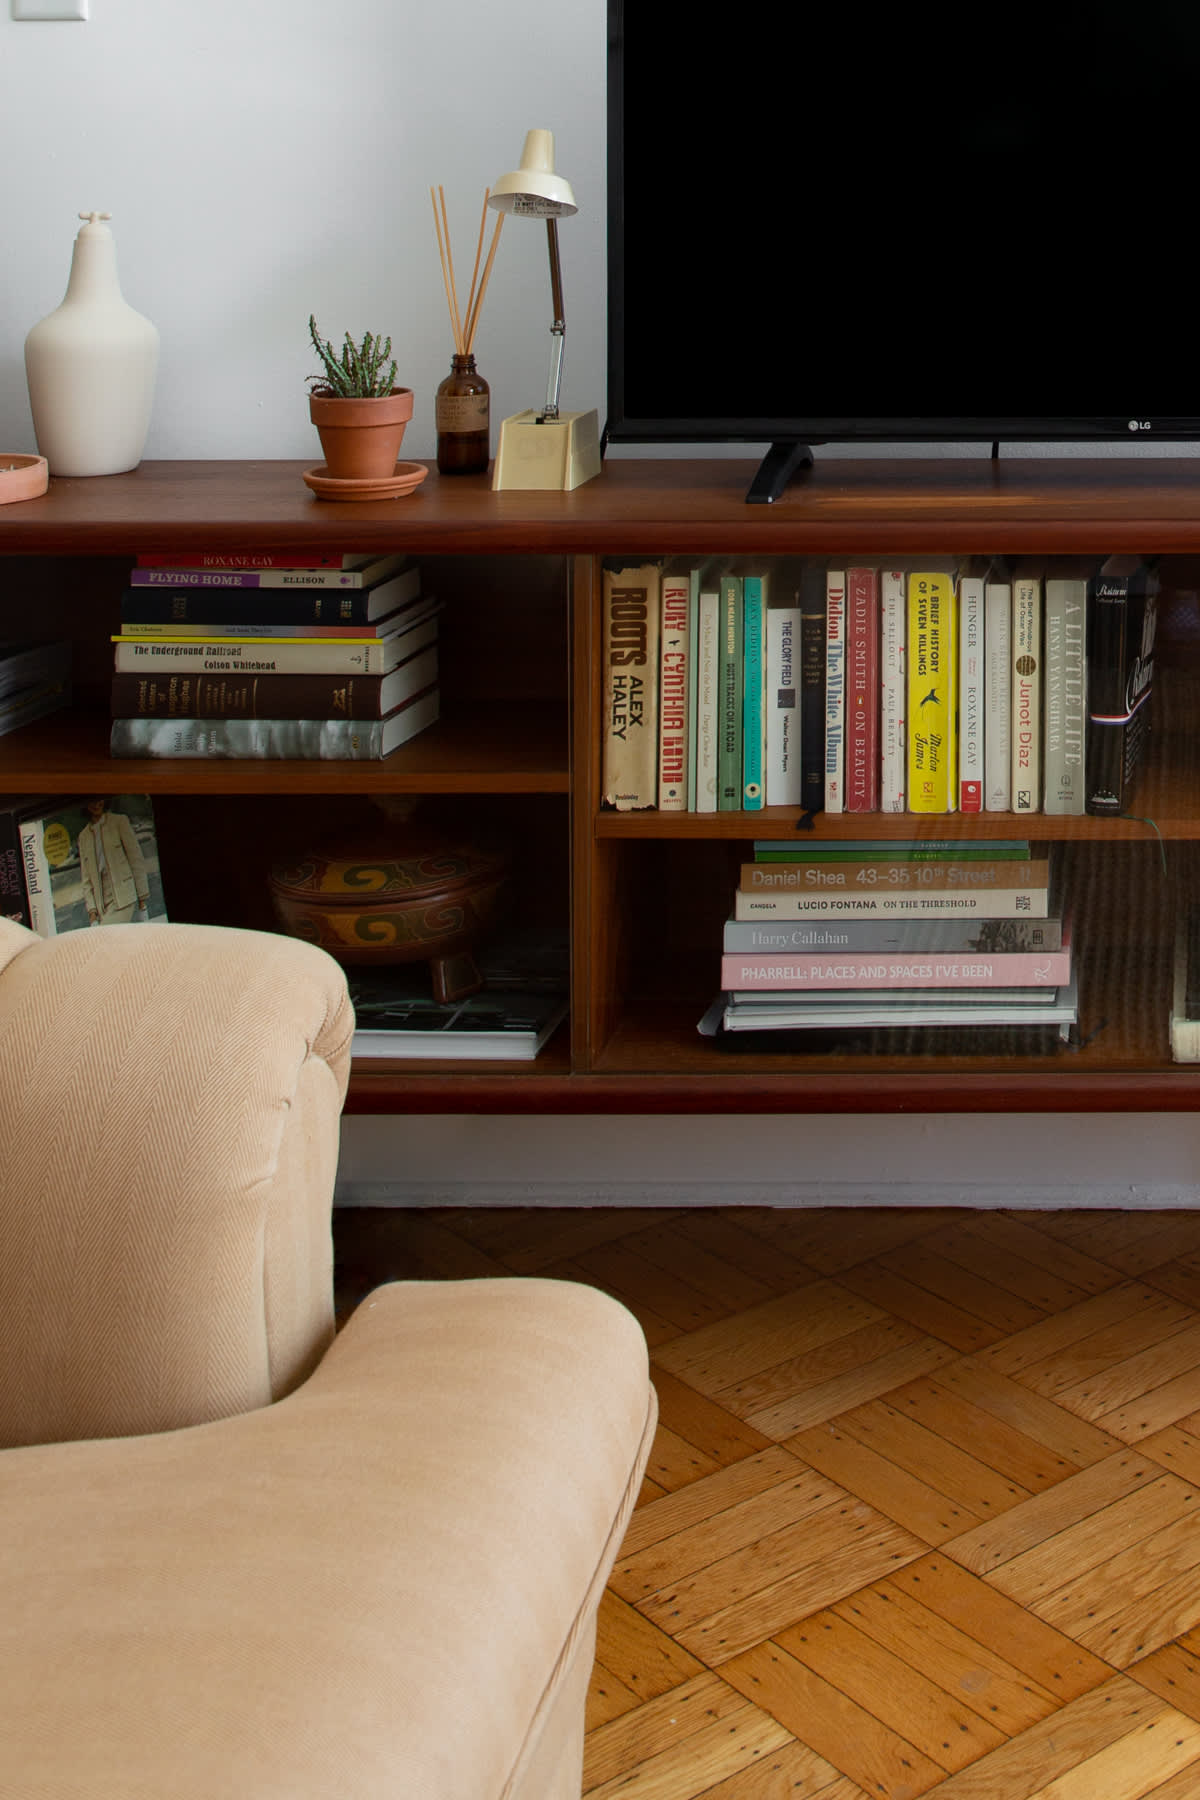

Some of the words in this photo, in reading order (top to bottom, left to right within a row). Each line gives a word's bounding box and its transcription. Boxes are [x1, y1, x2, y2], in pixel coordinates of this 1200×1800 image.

[203, 556, 251, 567] ROXANE
[252, 556, 273, 567] GAY
[150, 573, 198, 584] FLYING
[201, 574, 242, 586] HOME
[918, 581, 928, 594] OF
[664, 588, 688, 631] RUBY
[828, 588, 843, 639] Didion
[854, 587, 866, 634] ZADIE
[930, 596, 940, 625] BRIEF
[1019, 601, 1026, 609] of
[1065, 601, 1082, 615] A
[611, 588, 648, 666] ROOTS
[781, 621, 792, 636] THE
[967, 596, 977, 648] HUNGER
[1050, 616, 1060, 660] HANYA
[134, 646, 149, 655] The
[151, 646, 203, 657] Underground
[206, 646, 241, 656] Railroad
[204, 661, 230, 670] Colson
[233, 661, 276, 670] Whitehead
[781, 638, 792, 663] GLORY
[827, 641, 843, 672] The
[854, 641, 866, 690] SMITH
[918, 634, 928, 676] KILLINGS
[930, 629, 940, 673] HISTORY
[1065, 624, 1082, 706] LITTLE
[726, 663, 735, 680] DUST
[781, 664, 792, 685] FIELD
[629, 675, 643, 727] ALEX
[662, 652, 686, 730] CYNTHIA
[726, 682, 735, 709] TRACKS
[827, 674, 843, 718] White
[887, 688, 895, 713] PAUL
[1019, 679, 1032, 726] Junot
[612, 675, 627, 741] HALEY
[726, 711, 735, 723] ON
[854, 711, 866, 731] ON
[967, 687, 977, 738] ROXANE
[1050, 665, 1060, 752] YANAGIHARA
[726, 732, 735, 753] ROAD
[827, 720, 843, 773] Album
[887, 718, 895, 757] BEATTY
[915, 732, 928, 770] James
[929, 733, 942, 772] Marlon
[967, 742, 977, 766] GAY
[1019, 732, 1032, 768] Díaz
[1065, 714, 1082, 766] LIFE
[854, 739, 866, 798] BEAUTY
[23, 834, 42, 895] Negroland
[752, 869, 800, 886] Daniel
[805, 869, 845, 885] Shea
[914, 866, 943, 883] 10th
[947, 867, 996, 883] Street
[798, 901, 828, 910] LUCIO
[831, 901, 877, 910] FONTANA
[920, 900, 976, 908] THRESHOLD
[752, 931, 788, 947] Harry
[792, 931, 849, 945] Callahan
[741, 966, 808, 980] PHARRELL:
[811, 966, 856, 979] PLACES
[858, 966, 887, 979] AND
[889, 966, 933, 979] SPACES
[936, 965, 959, 978] I'VE
[962, 965, 993, 978] BEEN
